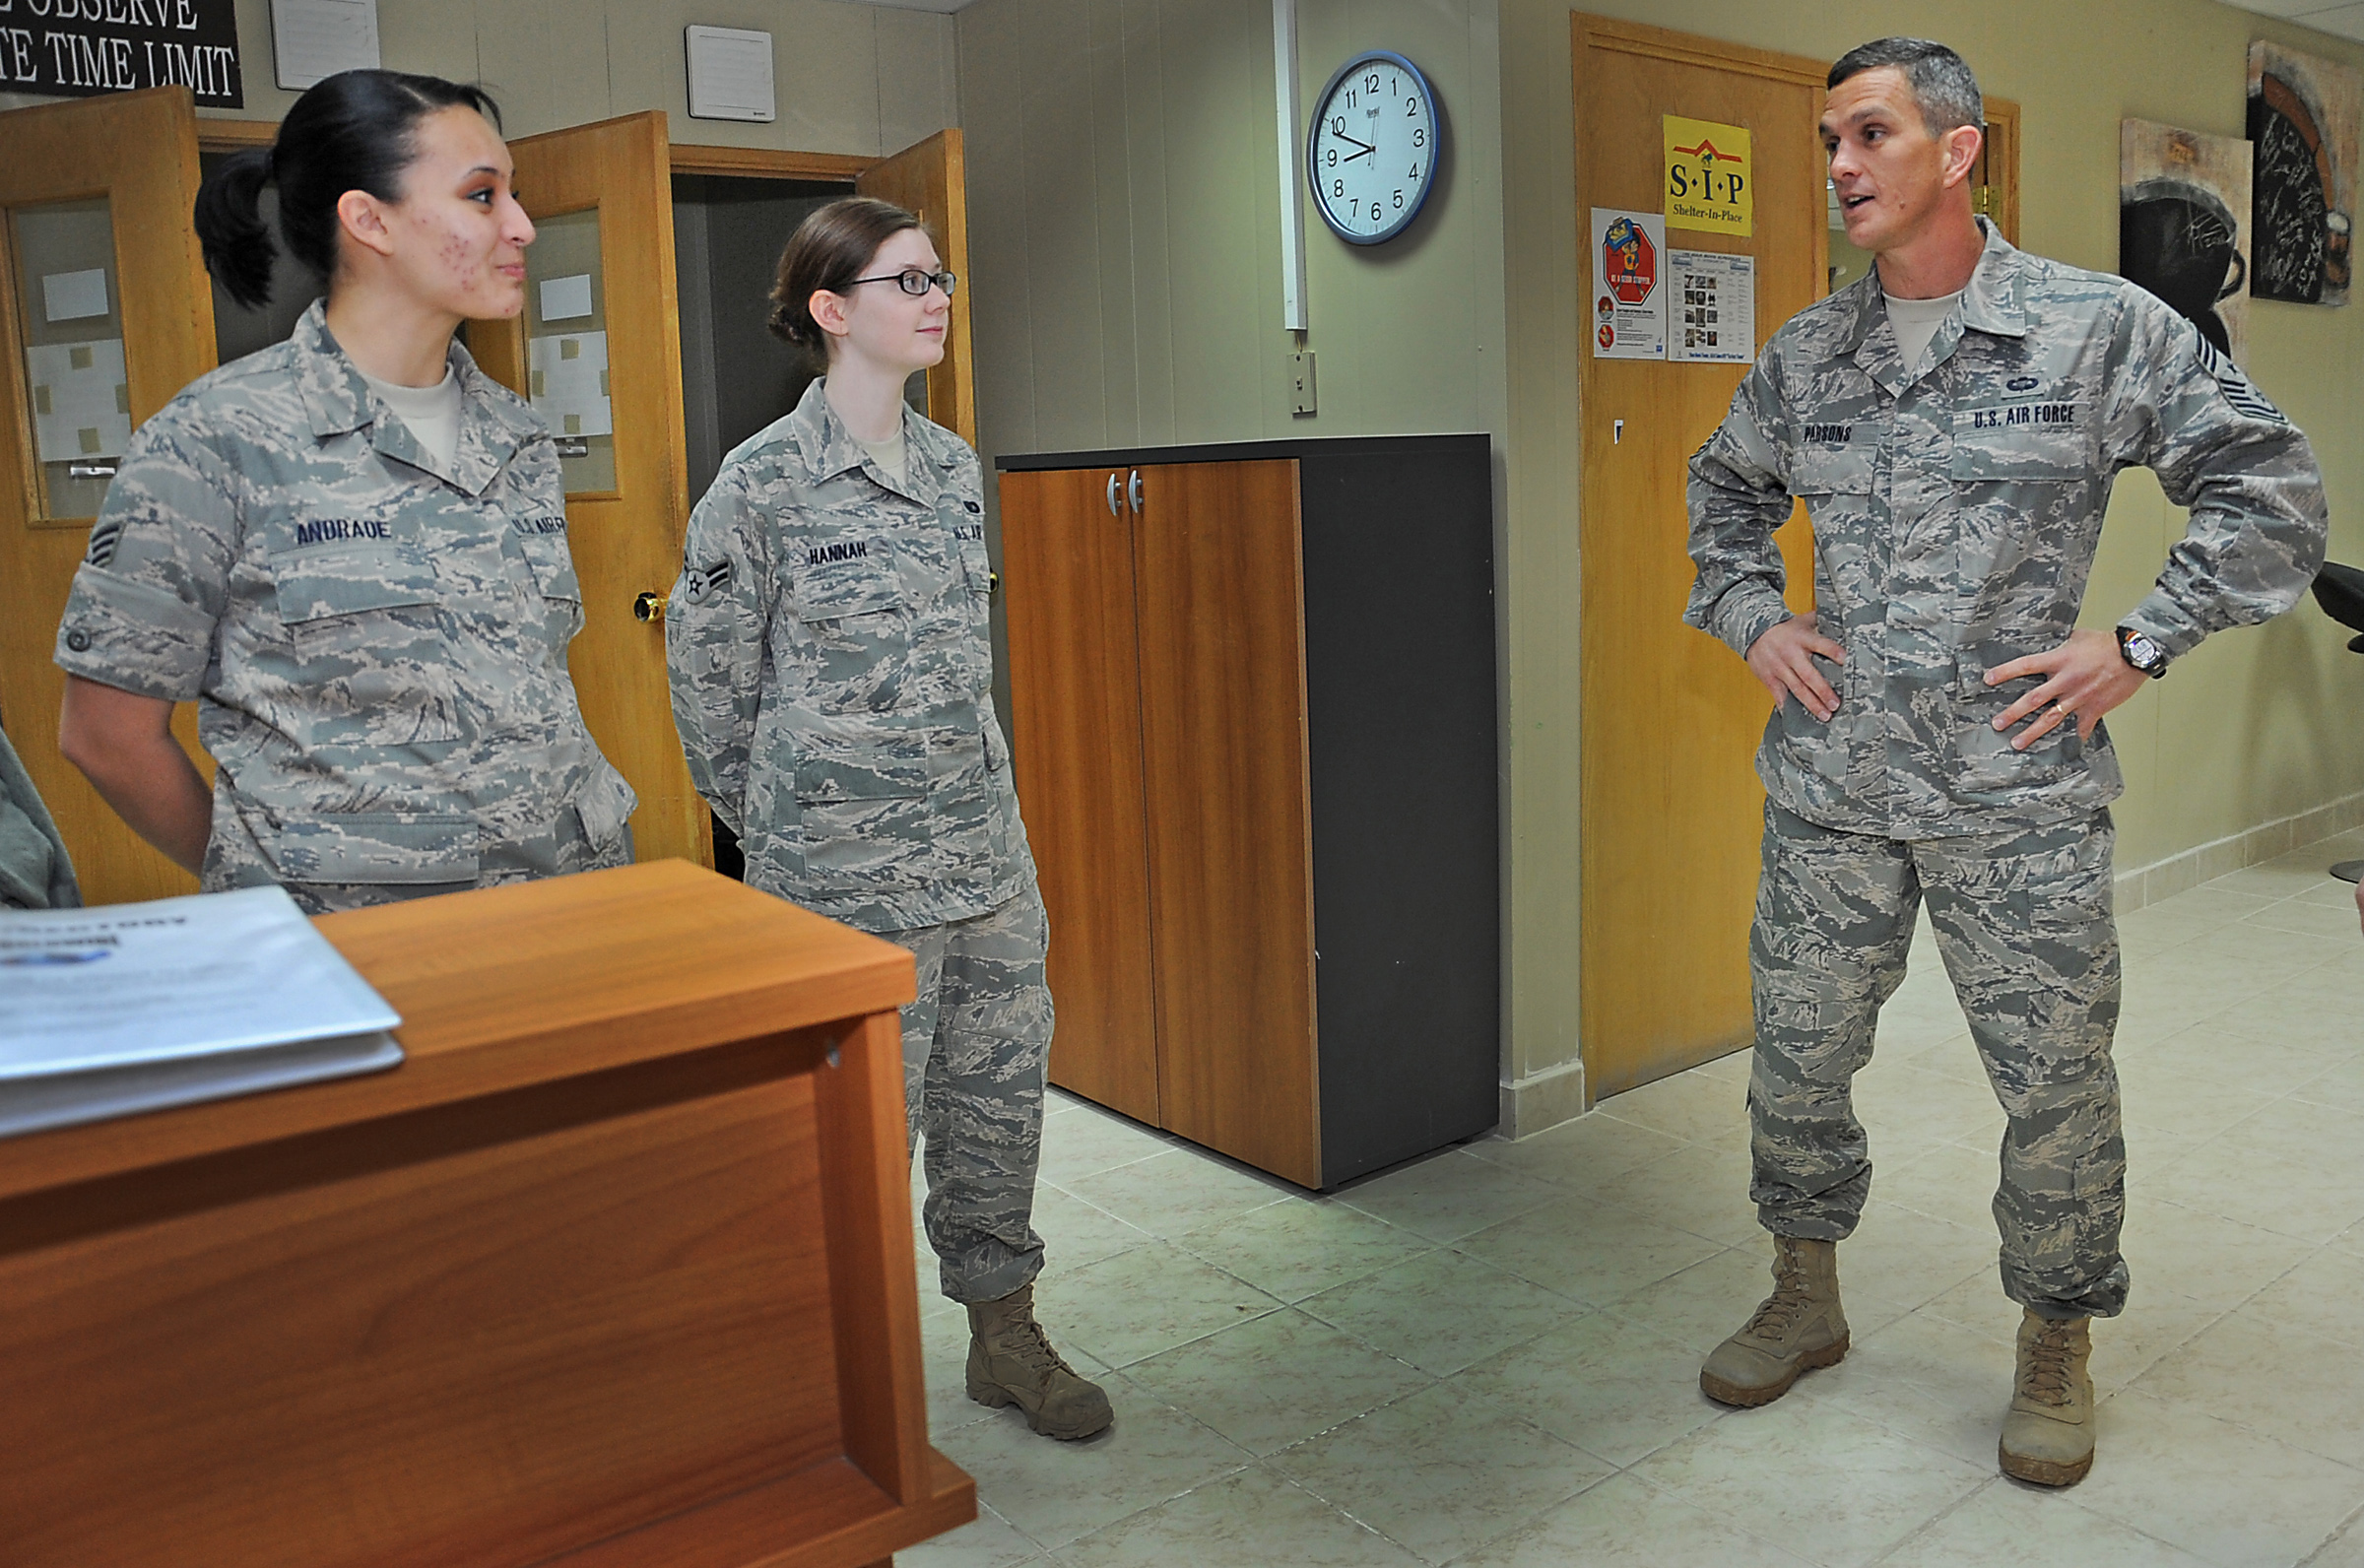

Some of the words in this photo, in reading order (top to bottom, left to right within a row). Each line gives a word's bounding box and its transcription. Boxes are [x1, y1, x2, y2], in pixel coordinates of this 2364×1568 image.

[44, 31, 136, 90] TIME
[144, 40, 235, 97] LIMIT
[1364, 74, 1379, 95] 12
[1391, 78, 1397, 97] 1
[1346, 89, 1356, 109] 11
[1406, 97, 1416, 117] 2
[1331, 115, 1346, 135] 10
[1412, 129, 1424, 148] 3
[1327, 149, 1337, 167] 9
[1409, 163, 1418, 181] 4
[1334, 179, 1344, 197] 8
[1349, 199, 1358, 218] 7
[1393, 189, 1403, 209] 5
[1370, 202, 1381, 221] 6
[1673, 203, 1743, 224] Shelter-In-Place
[1973, 411, 2002, 428] U.S.
[2005, 407, 2030, 425] AIR
[2033, 405, 2075, 424] FORCE
[1803, 425, 1852, 443] PARSONS
[809, 542, 868, 564] HANNAH
